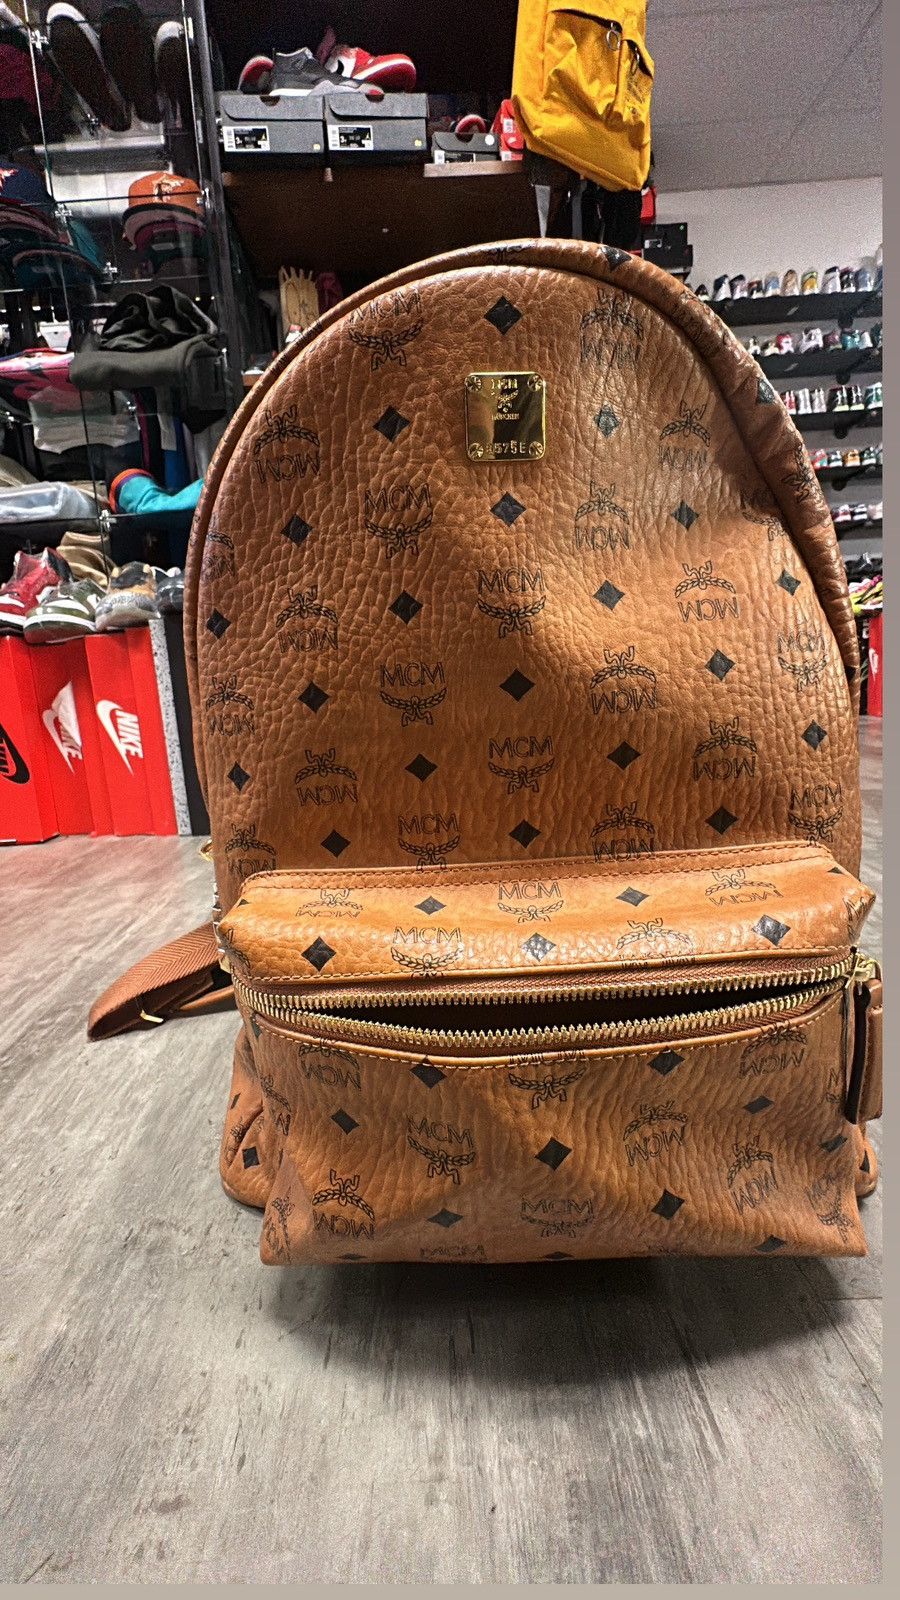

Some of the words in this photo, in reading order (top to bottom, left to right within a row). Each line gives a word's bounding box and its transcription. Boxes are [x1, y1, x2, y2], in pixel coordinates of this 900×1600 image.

[350, 291, 421, 322] MCM
[254, 452, 321, 484] MCM
[364, 482, 432, 513] MCM
[574, 525, 631, 550] MCM
[477, 566, 545, 595] MCM
[677, 596, 740, 623] MCM
[277, 625, 339, 654] MCM
[380, 660, 446, 688] MCM
[590, 687, 658, 715] MCM
[115, 709, 144, 759] NIKE
[208, 713, 256, 737] MCM
[488, 735, 555, 759] MCM
[692, 755, 757, 782] MCM
[296, 783, 359, 807] MCM
[790, 782, 843, 808] MCM
[397, 812, 461, 836] MCM
[592, 837, 656, 863] MCM
[498, 881, 563, 901] MCM
[708, 888, 785, 907] MCM
[391, 926, 464, 945] MCM
[300, 1058, 362, 1091] MCM
[739, 1047, 805, 1081] MCM
[406, 1113, 475, 1149] MCM
[624, 1124, 687, 1168] MCM
[520, 1198, 594, 1215] MCM
[730, 1172, 780, 1216] MCM
[312, 1209, 376, 1241] MCM
